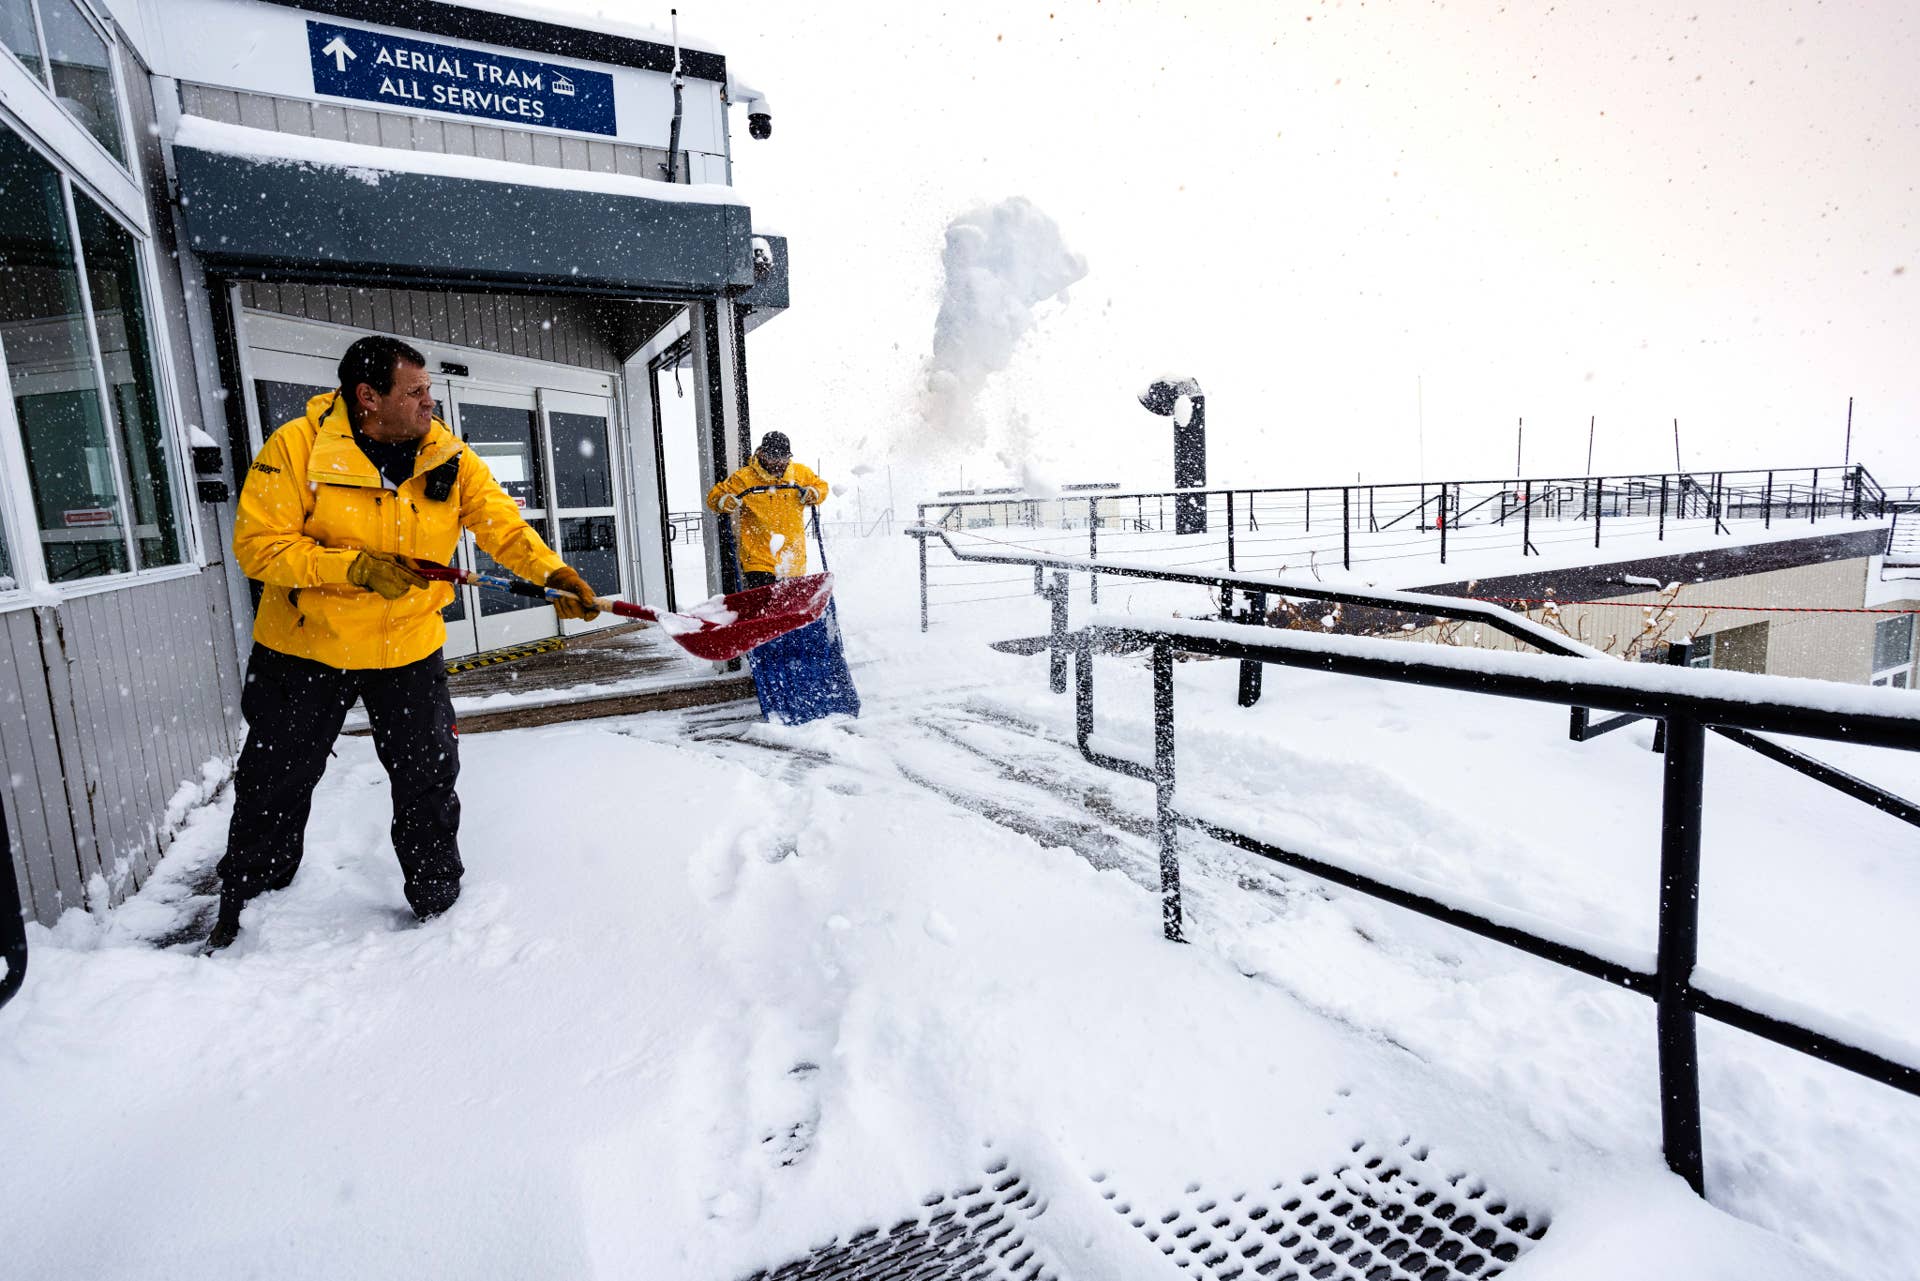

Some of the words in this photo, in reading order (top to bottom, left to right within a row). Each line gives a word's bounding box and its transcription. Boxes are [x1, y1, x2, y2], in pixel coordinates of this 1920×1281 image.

[375, 46, 468, 79] AERIAL
[473, 62, 542, 91] TRAM
[379, 76, 426, 101] ALL
[432, 84, 545, 118] SERVICES
